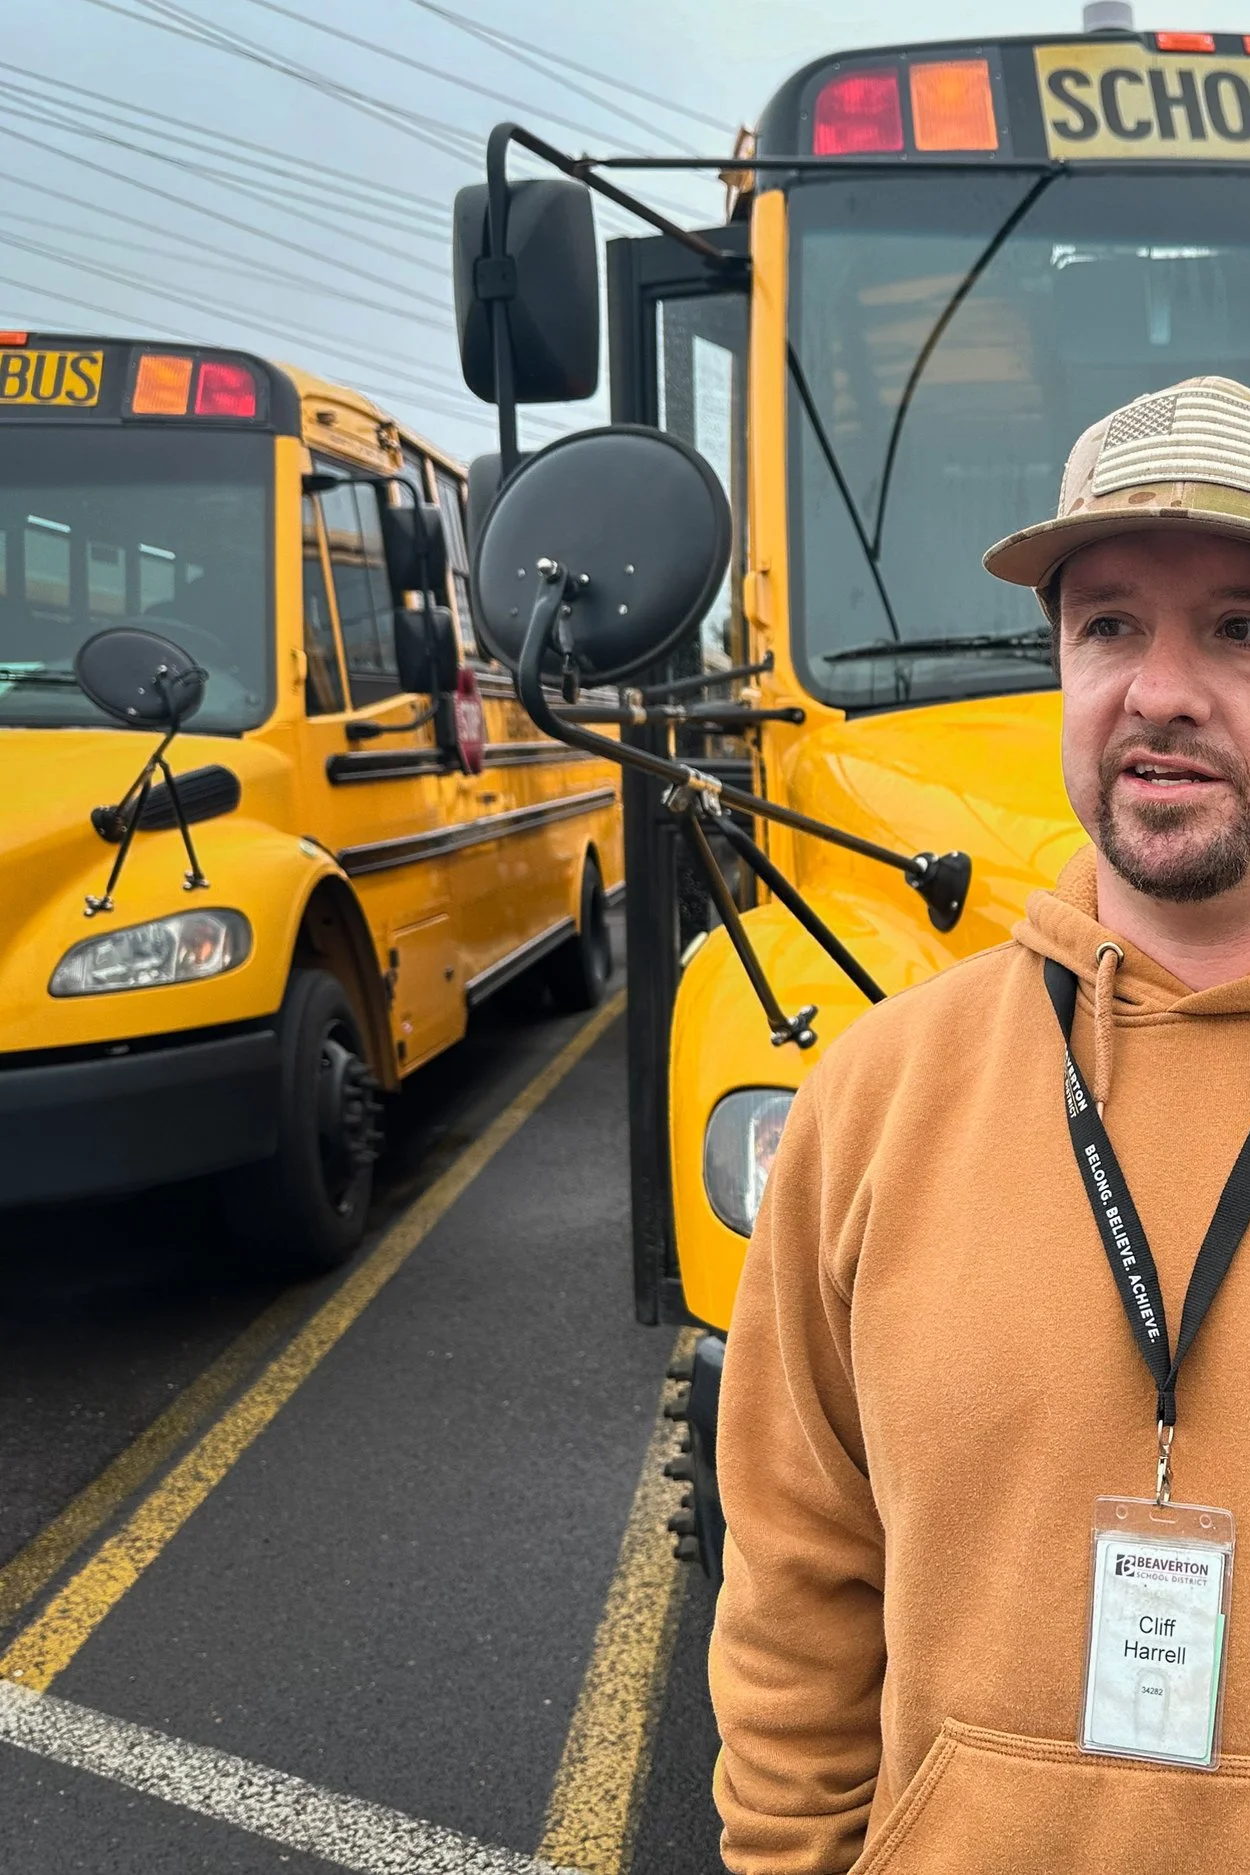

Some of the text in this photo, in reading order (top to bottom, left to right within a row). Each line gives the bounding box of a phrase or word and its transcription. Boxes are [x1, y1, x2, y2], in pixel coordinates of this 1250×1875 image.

[0, 354, 98, 401] BUS
[1084, 1143, 1161, 1344] BELONG. BELIEVE. ACHIEVE.
[1137, 1556, 1209, 1576] BEAVERTON
[1136, 1571, 1208, 1587] SCHOOL DISTRICT
[1139, 1615, 1177, 1637] Cliff
[1124, 1639, 1186, 1665] Harrell
[1140, 1686, 1164, 1696] 34282
